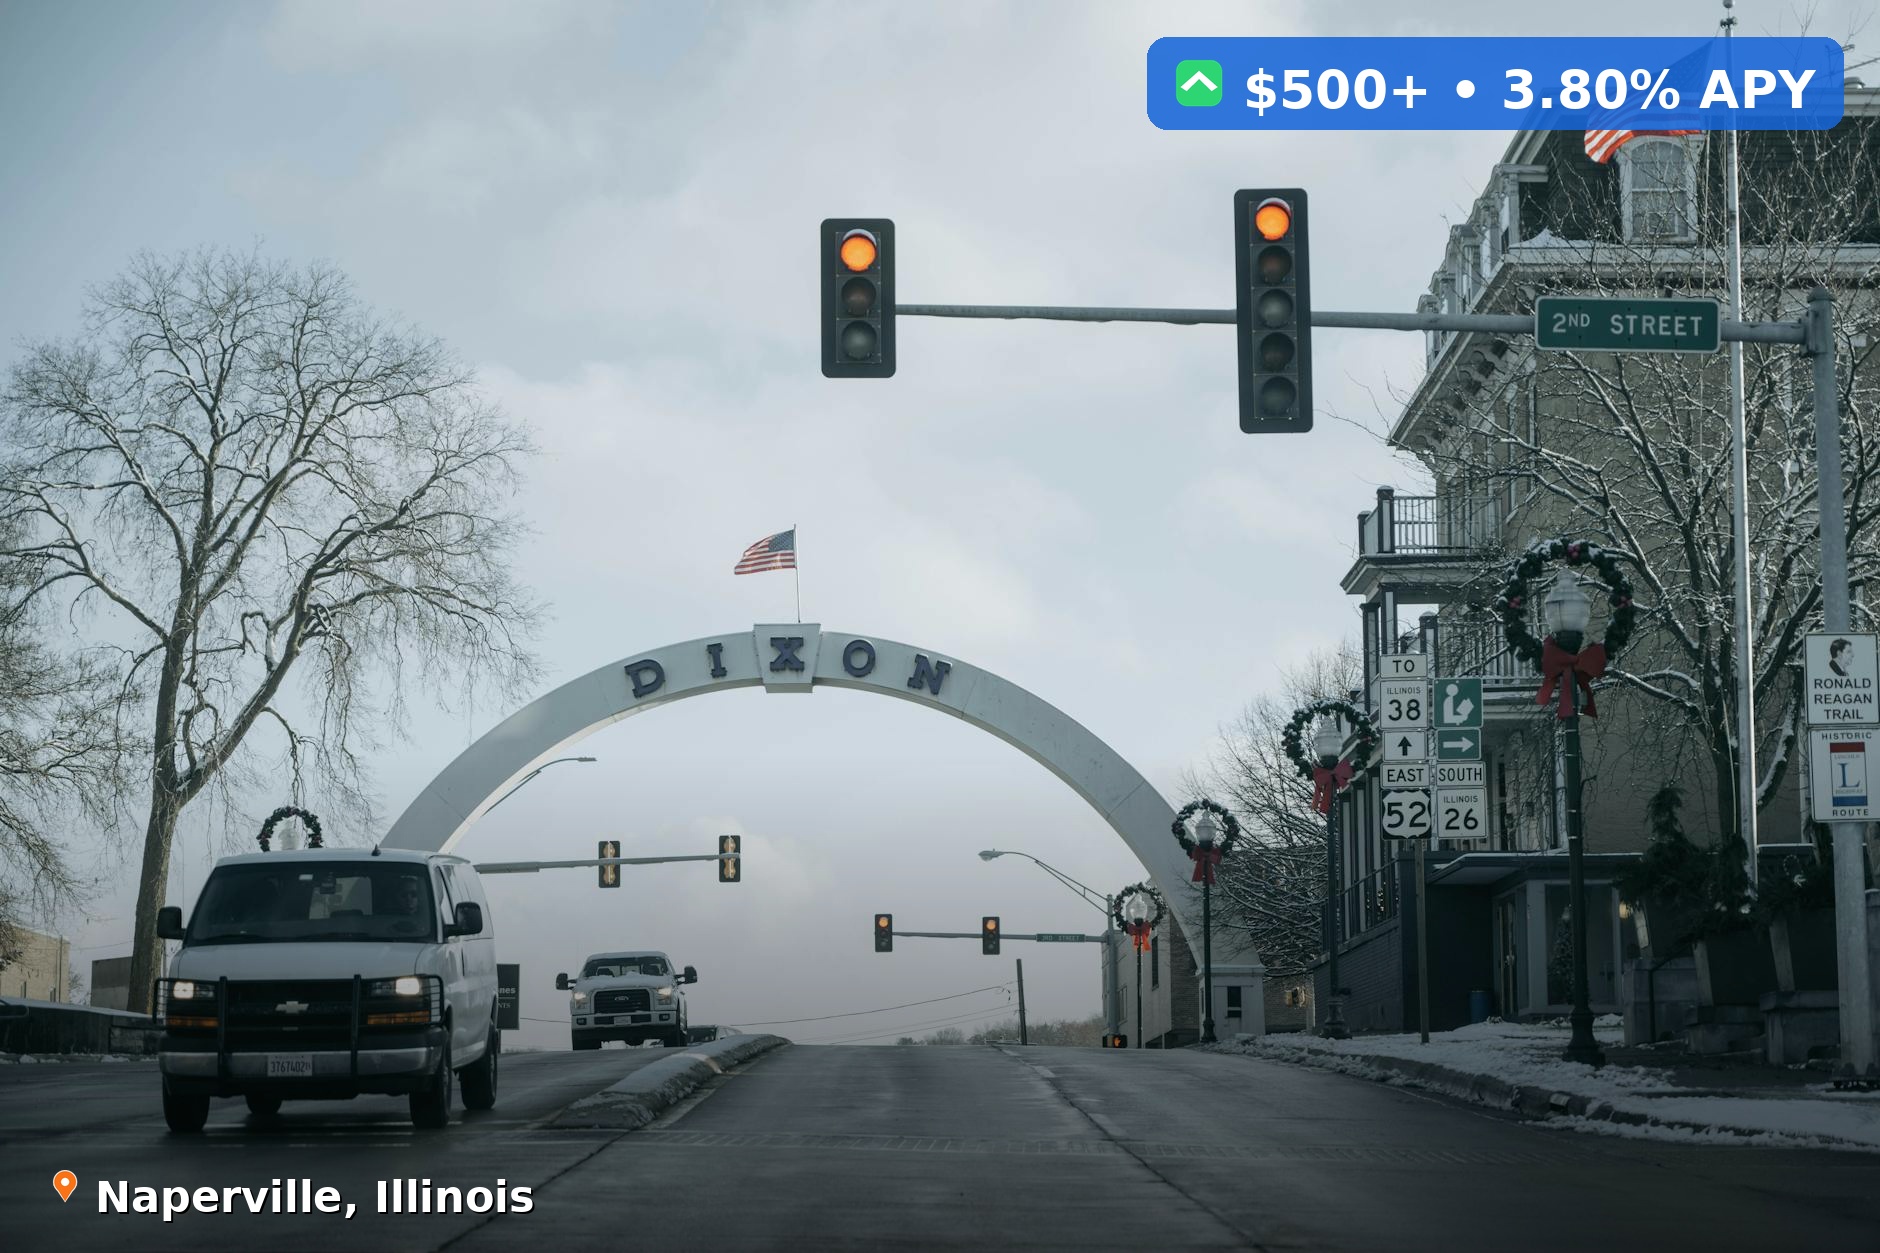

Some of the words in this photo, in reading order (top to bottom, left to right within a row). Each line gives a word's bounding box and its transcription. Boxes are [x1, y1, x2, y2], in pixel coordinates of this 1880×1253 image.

[1552, 312, 1591, 333] 2ND
[1610, 314, 1703, 337] STREET
[624, 637, 952, 698] DIXON
[1392, 659, 1415, 673] TO
[1386, 686, 1421, 695] ILLINOIS
[1814, 678, 1871, 689] RONALD
[1814, 693, 1872, 705] REAGAN
[1388, 699, 1421, 721] 38
[1824, 709, 1864, 720] TRAIL
[1822, 732, 1872, 740] HISTORIC
[1387, 768, 1424, 783] EAST
[1438, 767, 1482, 782] SOUTH
[1837, 762, 1861, 788] L
[1443, 795, 1478, 804] ILLINOIS
[1387, 801, 1427, 829] 52
[1445, 808, 1479, 830] 26
[1832, 808, 1869, 817] ROUTE
